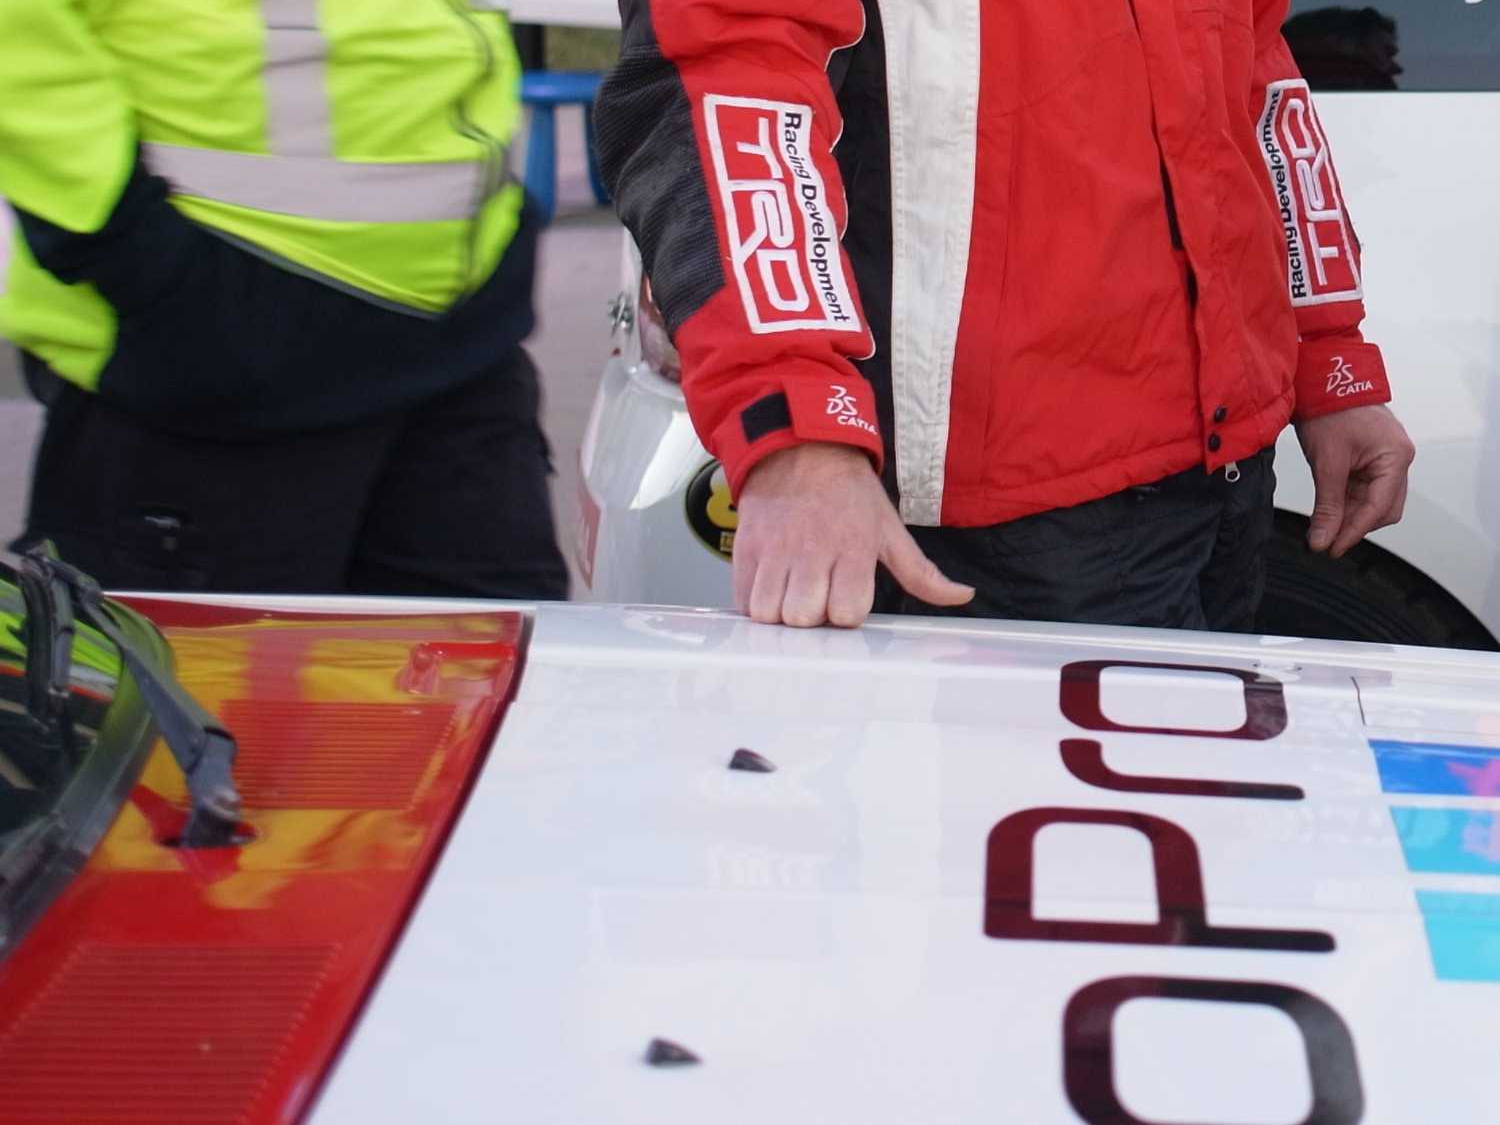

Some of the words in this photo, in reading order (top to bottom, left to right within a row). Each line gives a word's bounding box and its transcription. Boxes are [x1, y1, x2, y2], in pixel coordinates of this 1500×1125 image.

[728, 116, 810, 313] TRD
[783, 111, 812, 180] Racing
[801, 183, 851, 322] Development
[1263, 90, 1292, 225] Development
[1281, 97, 1343, 286] TRD
[1288, 227, 1307, 299] Racing
[1336, 380, 1374, 397] CATIA
[983, 659, 1365, 1125] oPro
